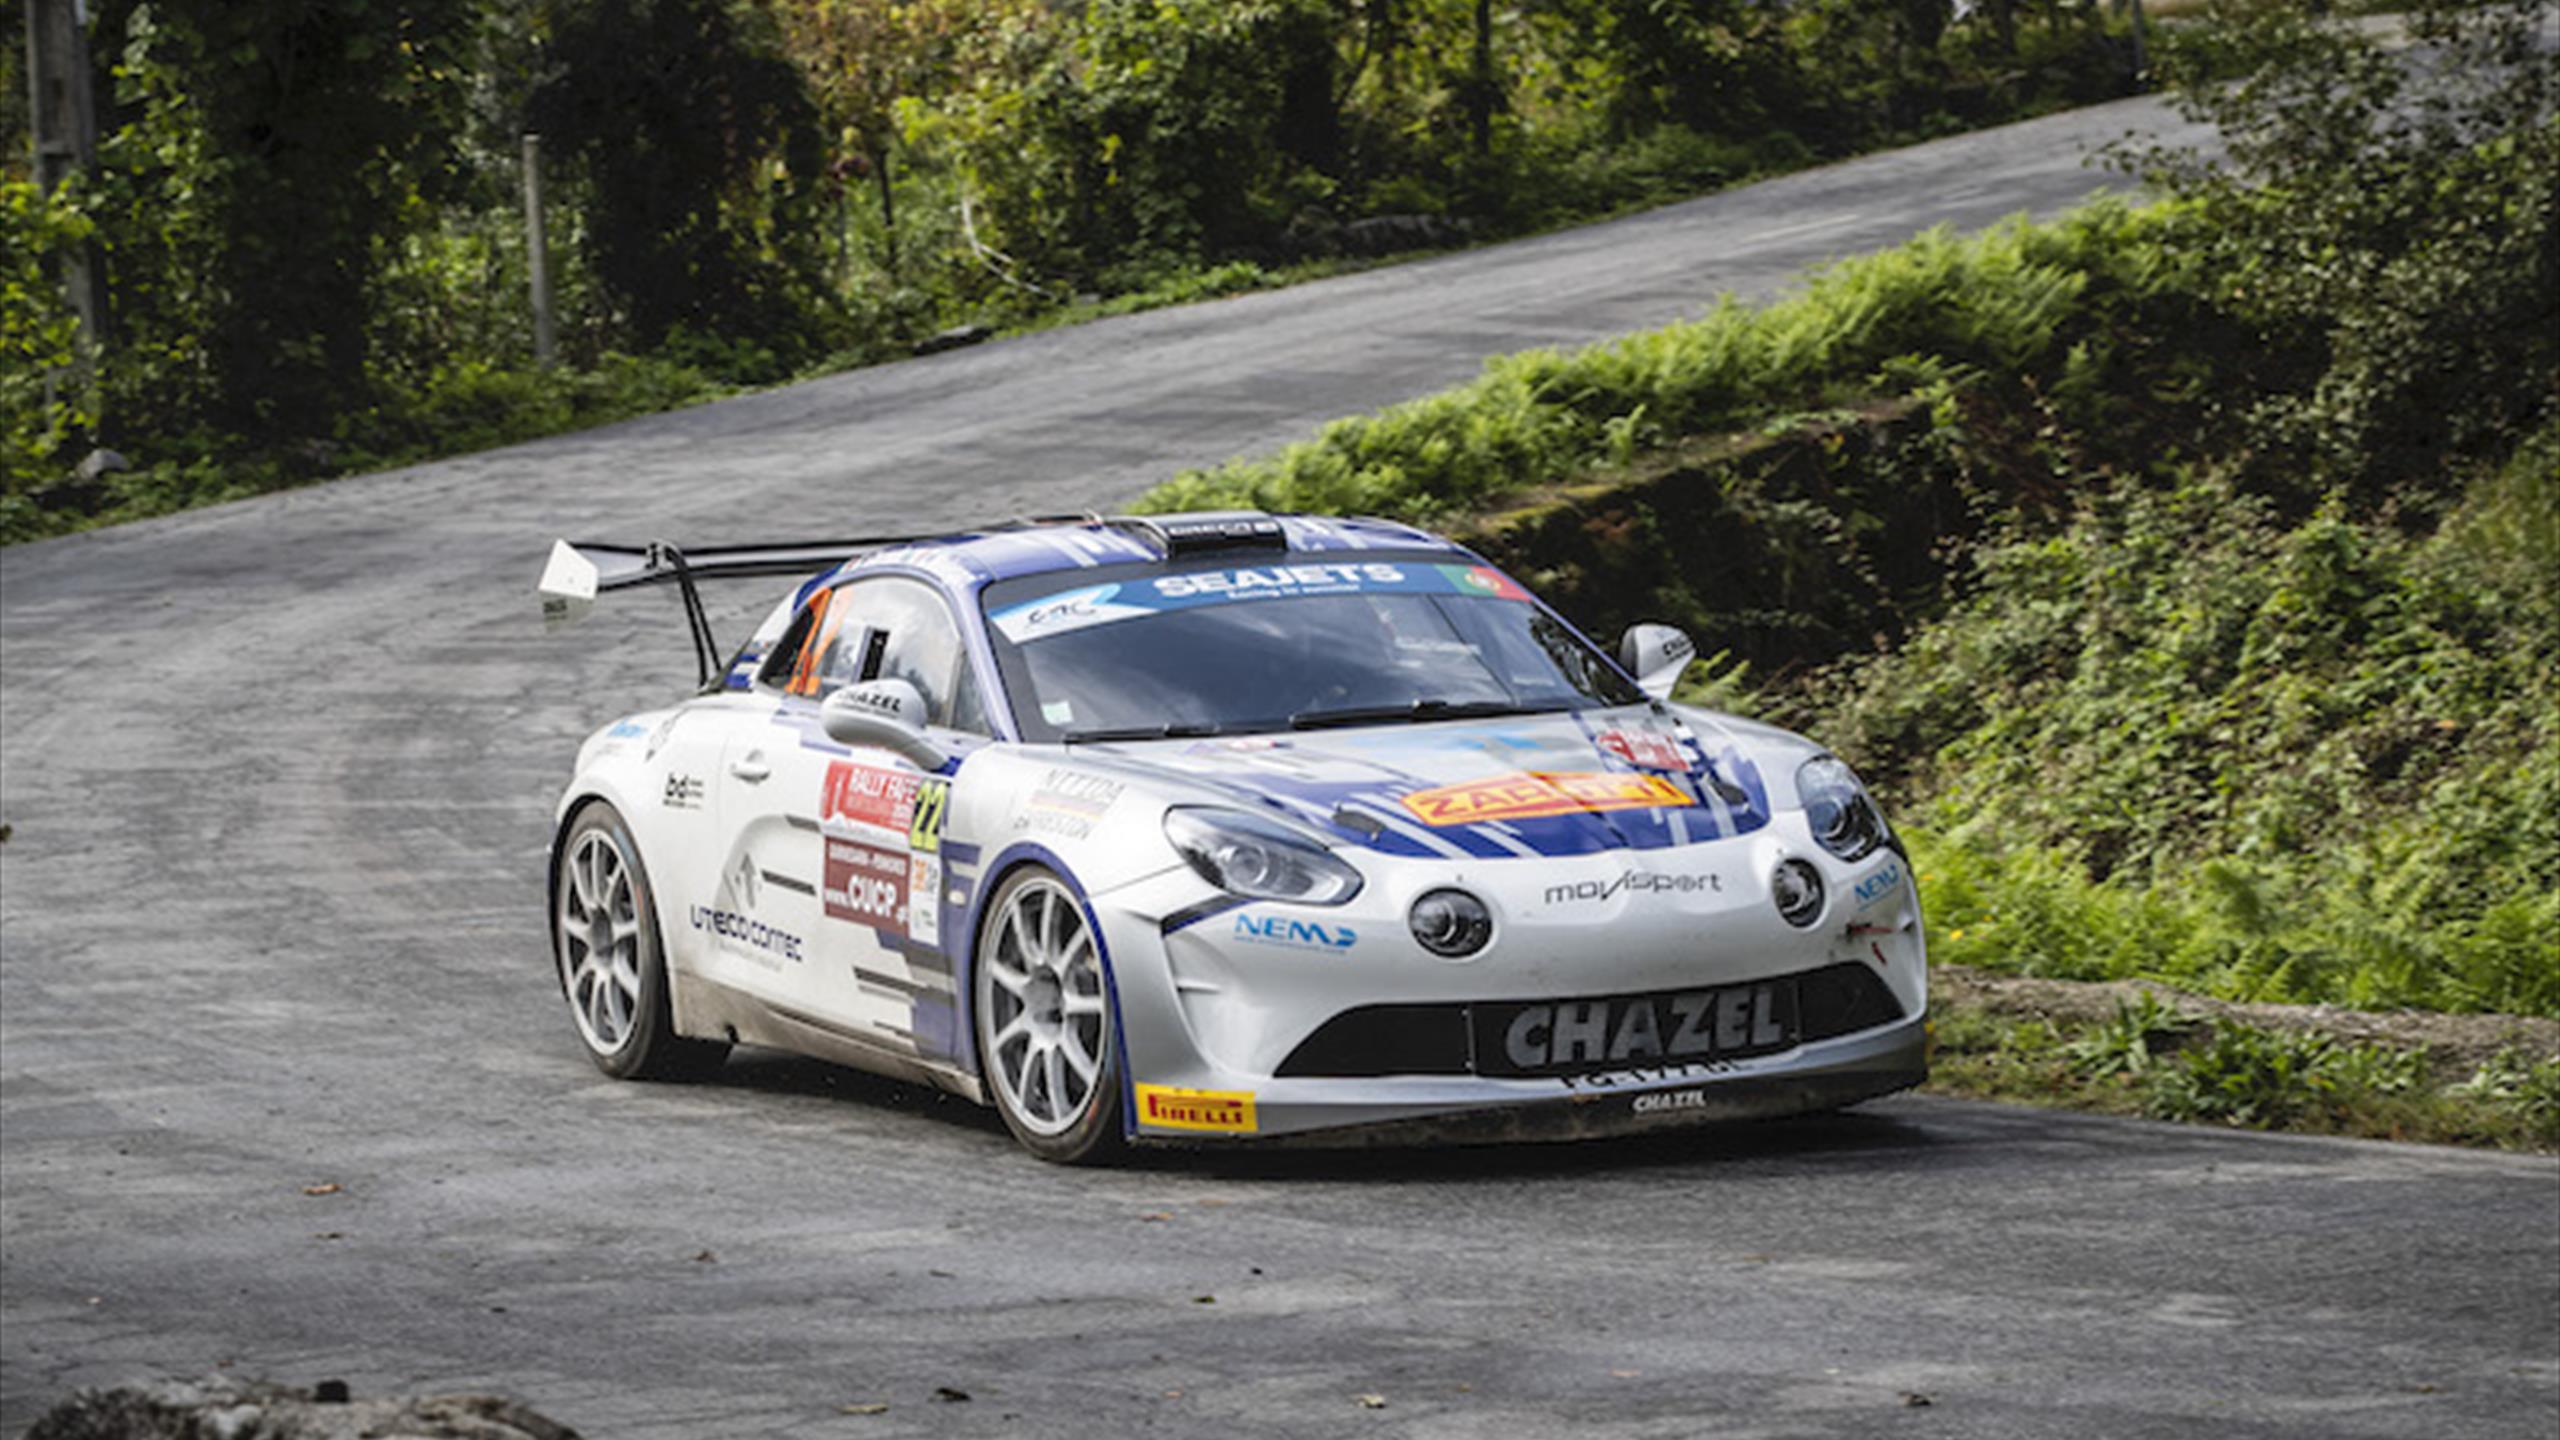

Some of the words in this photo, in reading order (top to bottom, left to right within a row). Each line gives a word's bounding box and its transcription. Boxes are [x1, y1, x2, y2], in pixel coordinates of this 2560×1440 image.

[1154, 562, 1405, 597] SEAJETS
[910, 778, 946, 851] 22
[1505, 987, 1782, 1069] CHAZEL
[1148, 1093, 1242, 1124] PIRELLI
[1632, 1090, 1705, 1112] CHAZEL
